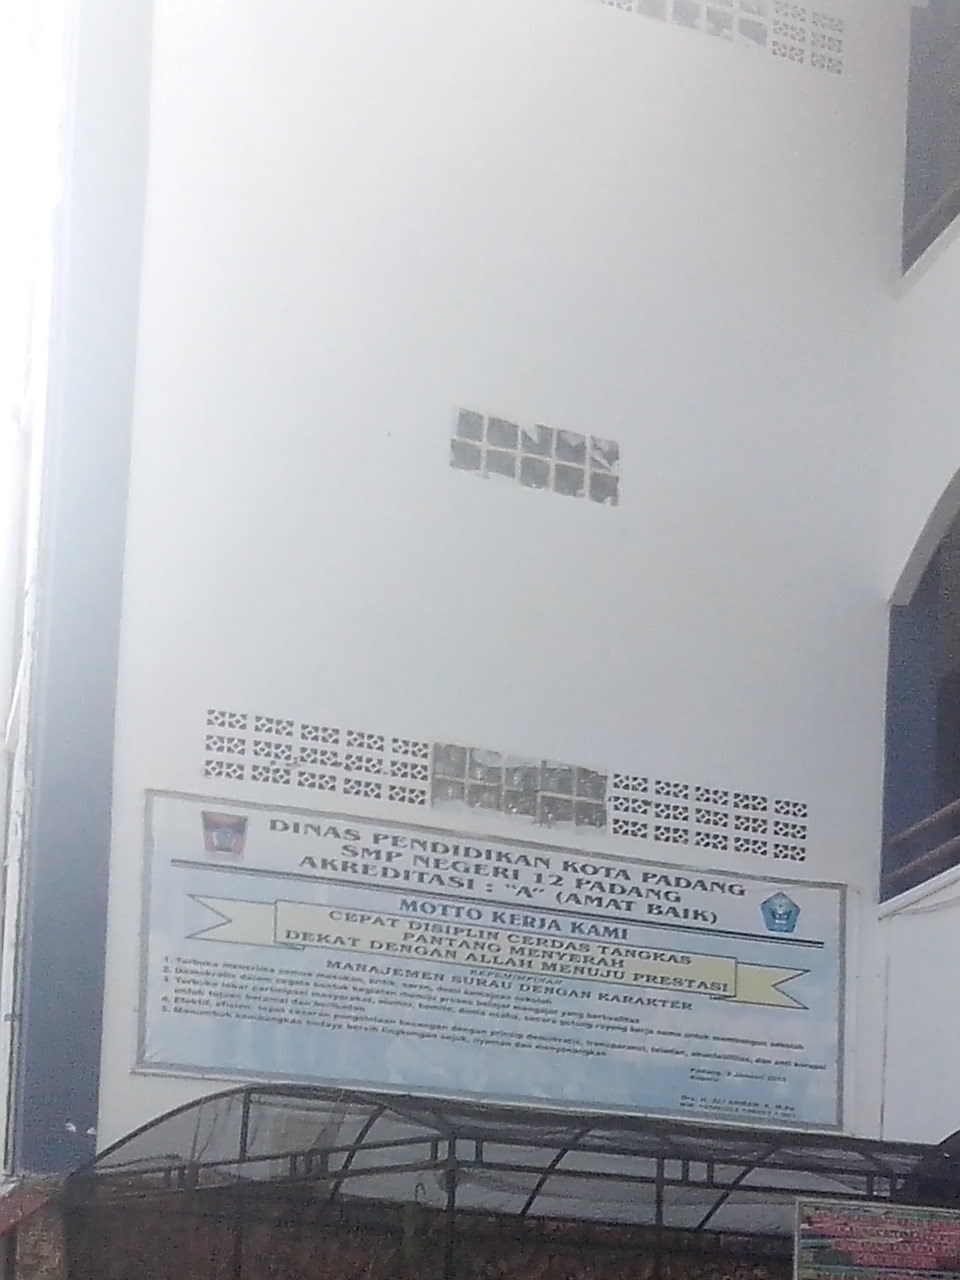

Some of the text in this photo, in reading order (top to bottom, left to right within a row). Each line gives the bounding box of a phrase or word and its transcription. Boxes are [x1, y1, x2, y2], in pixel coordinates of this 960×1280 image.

[269, 818, 746, 897] DINAS PENDIDIKAN KOTA PADANG
[340, 844, 682, 903] SMP NEGERI 12 PADANG
[298, 855, 475, 890] AKREDITASI
[555, 890, 637, 912] (AMAT
[647, 903, 718, 925] BAIK)
[328, 910, 692, 965] CEPAT DISIPLIN CERDAS TANGKAS
[399, 898, 628, 940] MOTTO KERJA KAMI
[285, 929, 728, 993] DEKAT DENGAN ALLAH MENUJU PRESTASI
[402, 931, 625, 969] PANTANG MENYERAH
[326, 959, 445, 982] MANAJEMEN
[519, 983, 592, 999] DENGAN
[597, 992, 693, 1011] KARAKTER
